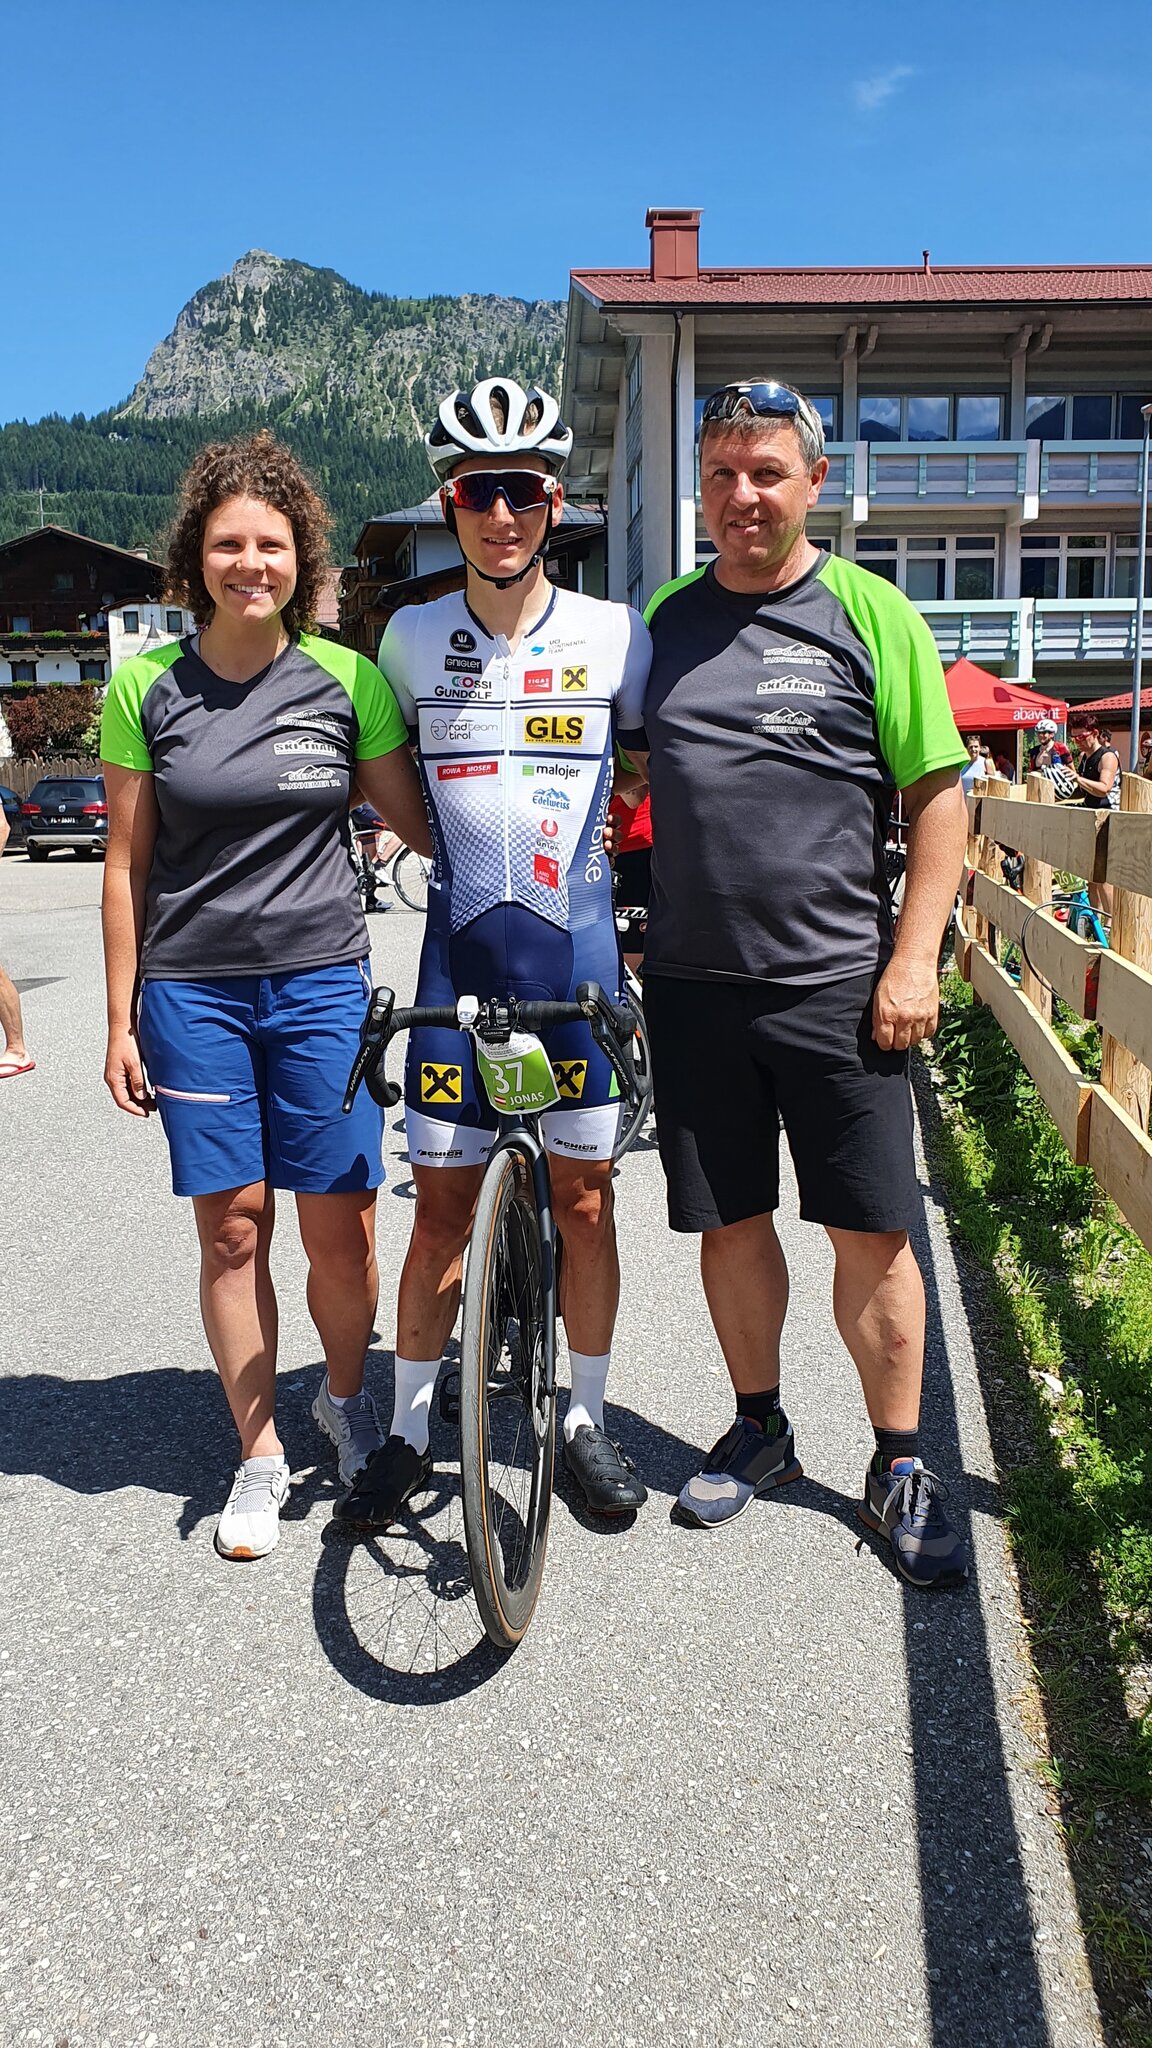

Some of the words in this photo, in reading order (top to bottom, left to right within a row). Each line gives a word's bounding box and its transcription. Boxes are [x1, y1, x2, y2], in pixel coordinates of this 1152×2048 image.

[434, 685, 493, 700] GUNDOLF
[1013, 707, 1061, 721] abavent
[449, 731, 471, 740] tirol
[526, 717, 582, 740] GLS
[442, 767, 461, 776] ROWA
[466, 764, 492, 773] MOSER
[536, 763, 581, 780] malojer
[532, 794, 570, 811] Edelweiss
[488, 1061, 523, 1095] 37
[509, 1091, 545, 1106] JONAS
